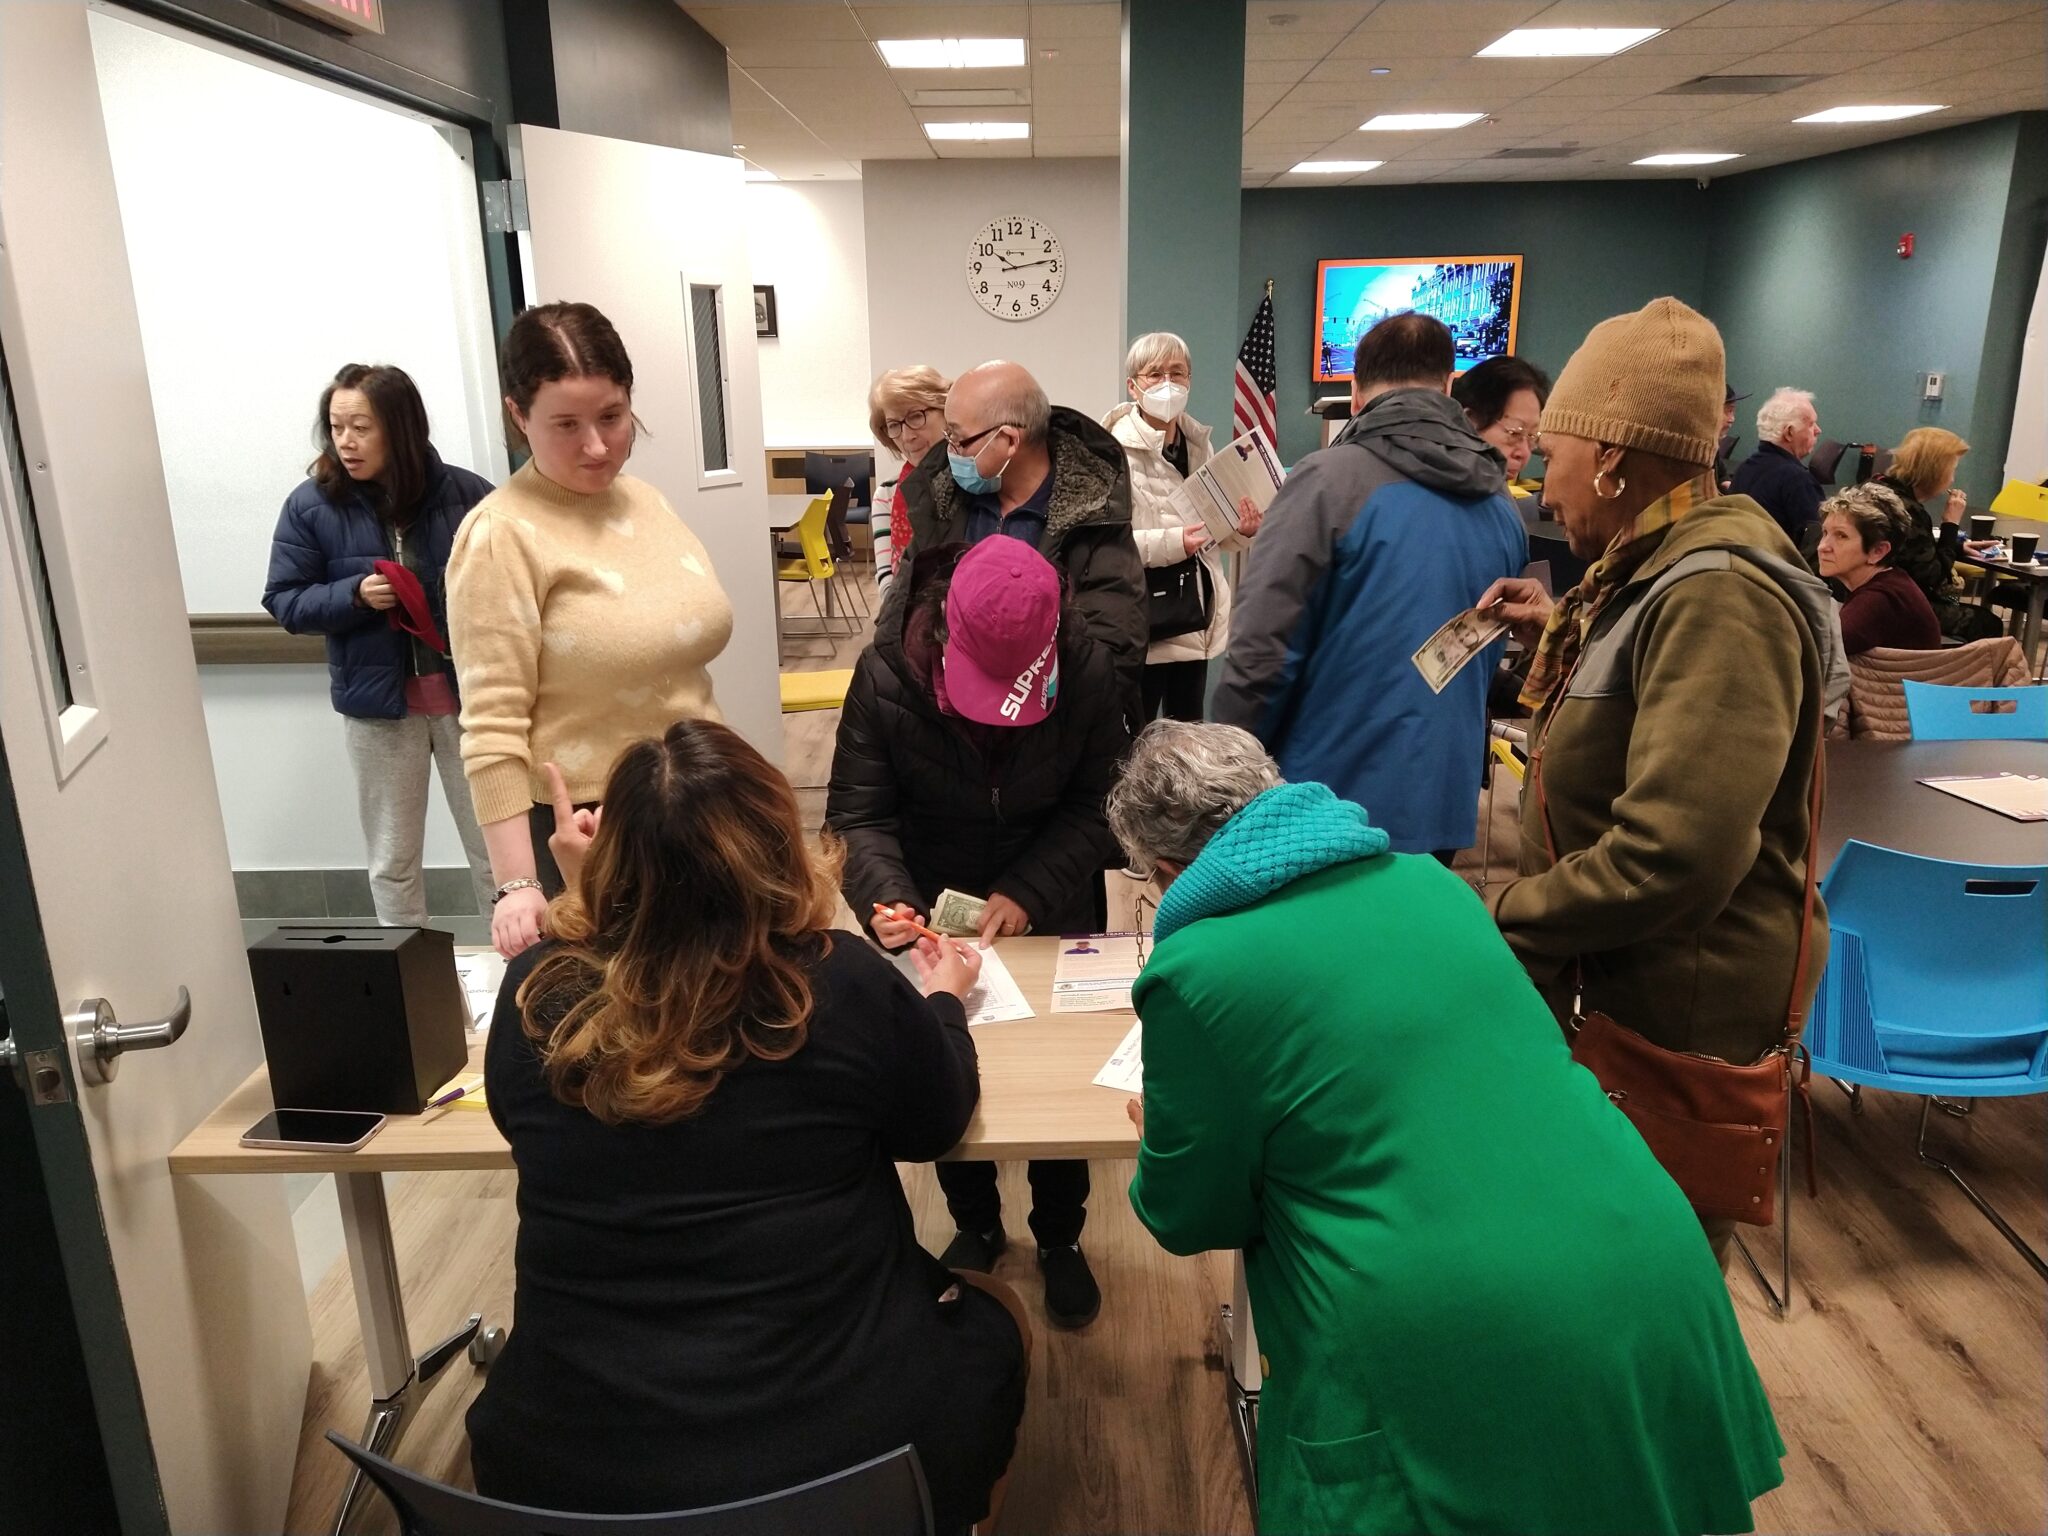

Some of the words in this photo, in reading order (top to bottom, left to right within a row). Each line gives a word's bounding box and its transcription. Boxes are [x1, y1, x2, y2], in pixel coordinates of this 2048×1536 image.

[991, 228, 1003, 241] 11
[1007, 222, 1022, 235] 12
[1030, 226, 1036, 239] 1
[978, 243, 994, 256] 10
[1043, 240, 1052, 253] 2
[973, 262, 982, 274] 9
[1049, 260, 1058, 273] 3
[980, 281, 988, 294] 8
[1042, 279, 1051, 292] 4
[994, 295, 1002, 307] 7
[1012, 300, 1021, 312] 6
[1030, 294, 1039, 307] 5
[1000, 611, 1060, 721] SUPRE
